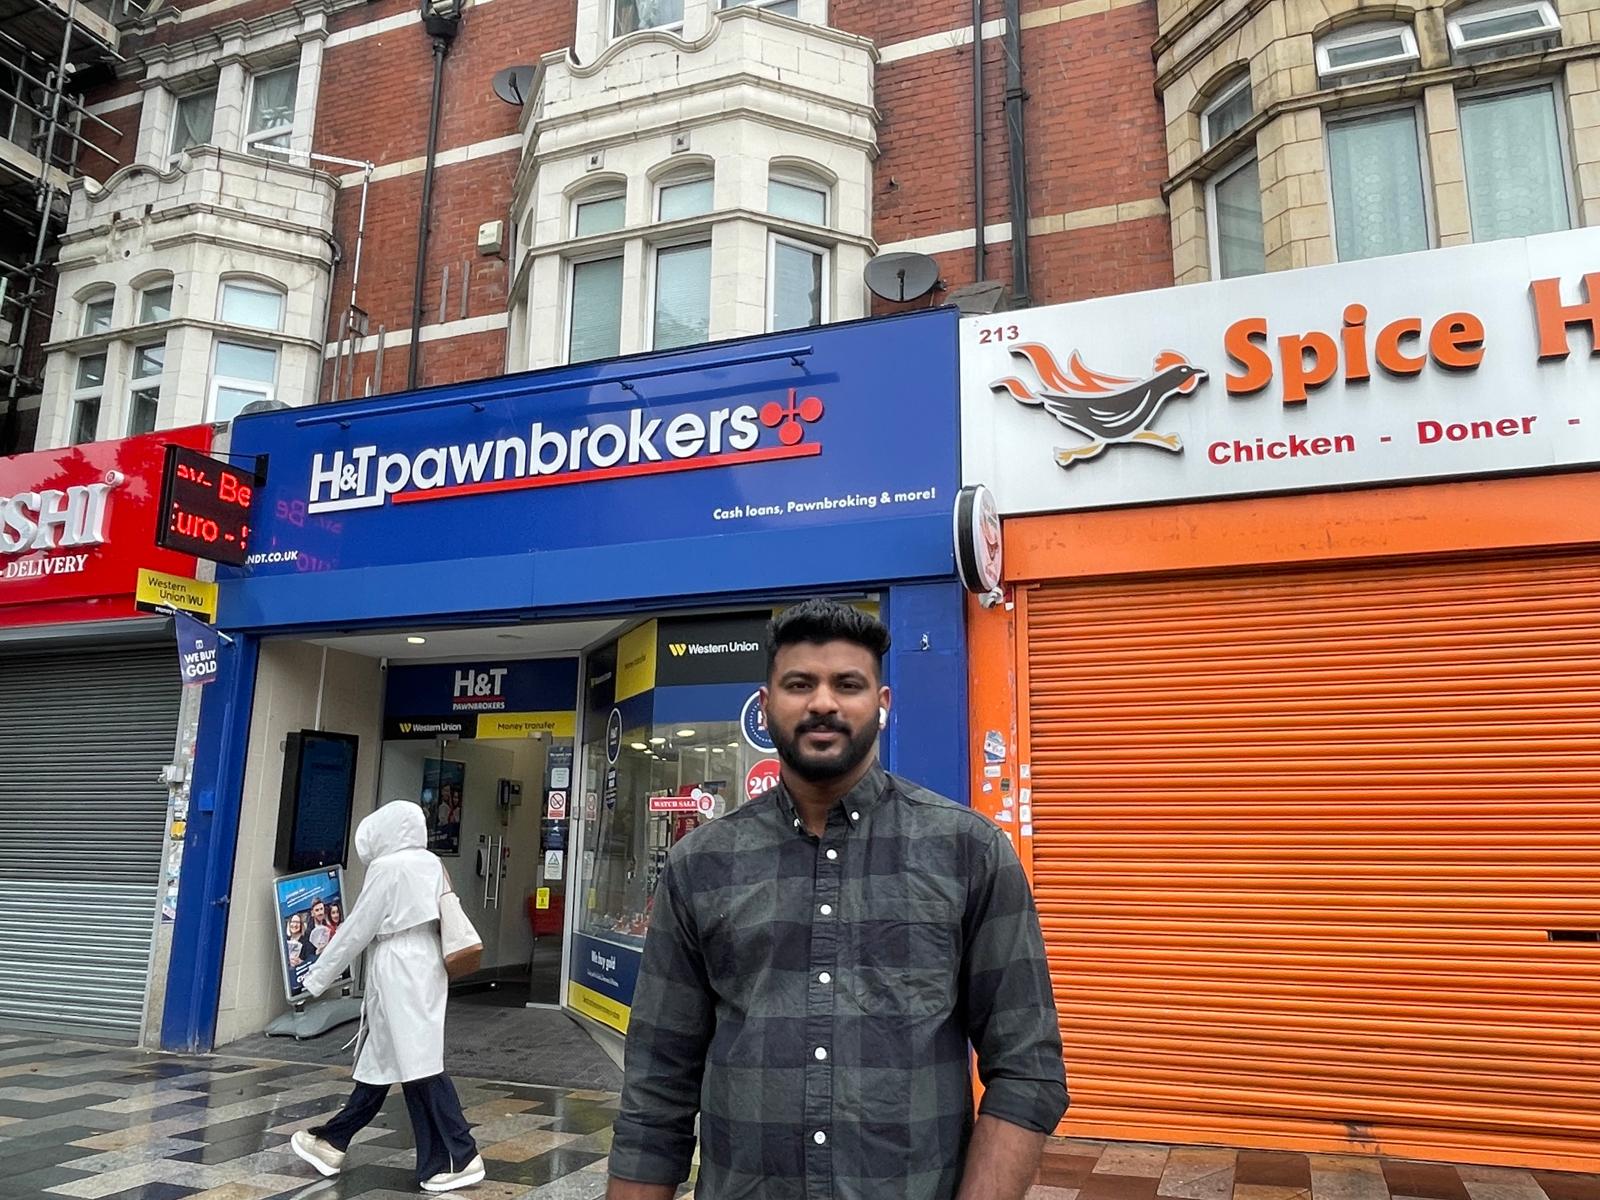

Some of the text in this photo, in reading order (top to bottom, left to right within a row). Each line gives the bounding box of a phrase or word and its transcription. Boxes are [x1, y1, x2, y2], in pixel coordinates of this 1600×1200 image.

[978, 324, 1020, 344] 213
[1222, 271, 1600, 407] Spice H
[1207, 434, 1356, 465] Chicken
[1417, 415, 1538, 444] Doner
[309, 406, 760, 506] H&T pawnbrokers
[219, 471, 253, 508] Be
[713, 487, 937, 520] Cash loans, Pawnbroking & more!
[0, 482, 112, 554] SHI
[5, 554, 89, 578] DELIVERY
[245, 551, 299, 565] NDT.CO.UK
[148, 576, 187, 592] Western
[160, 589, 186, 603] Union
[184, 649, 216, 664] WE BUY
[688, 641, 759, 655] Western Union
[186, 660, 217, 678] GOLD
[453, 668, 508, 697] H&T
[452, 702, 506, 711] PAWNBROKERS
[412, 722, 462, 733] Western Union
[497, 721, 556, 732] Money transfer
[749, 774, 780, 795] 20
[653, 800, 679, 808] WATCH
